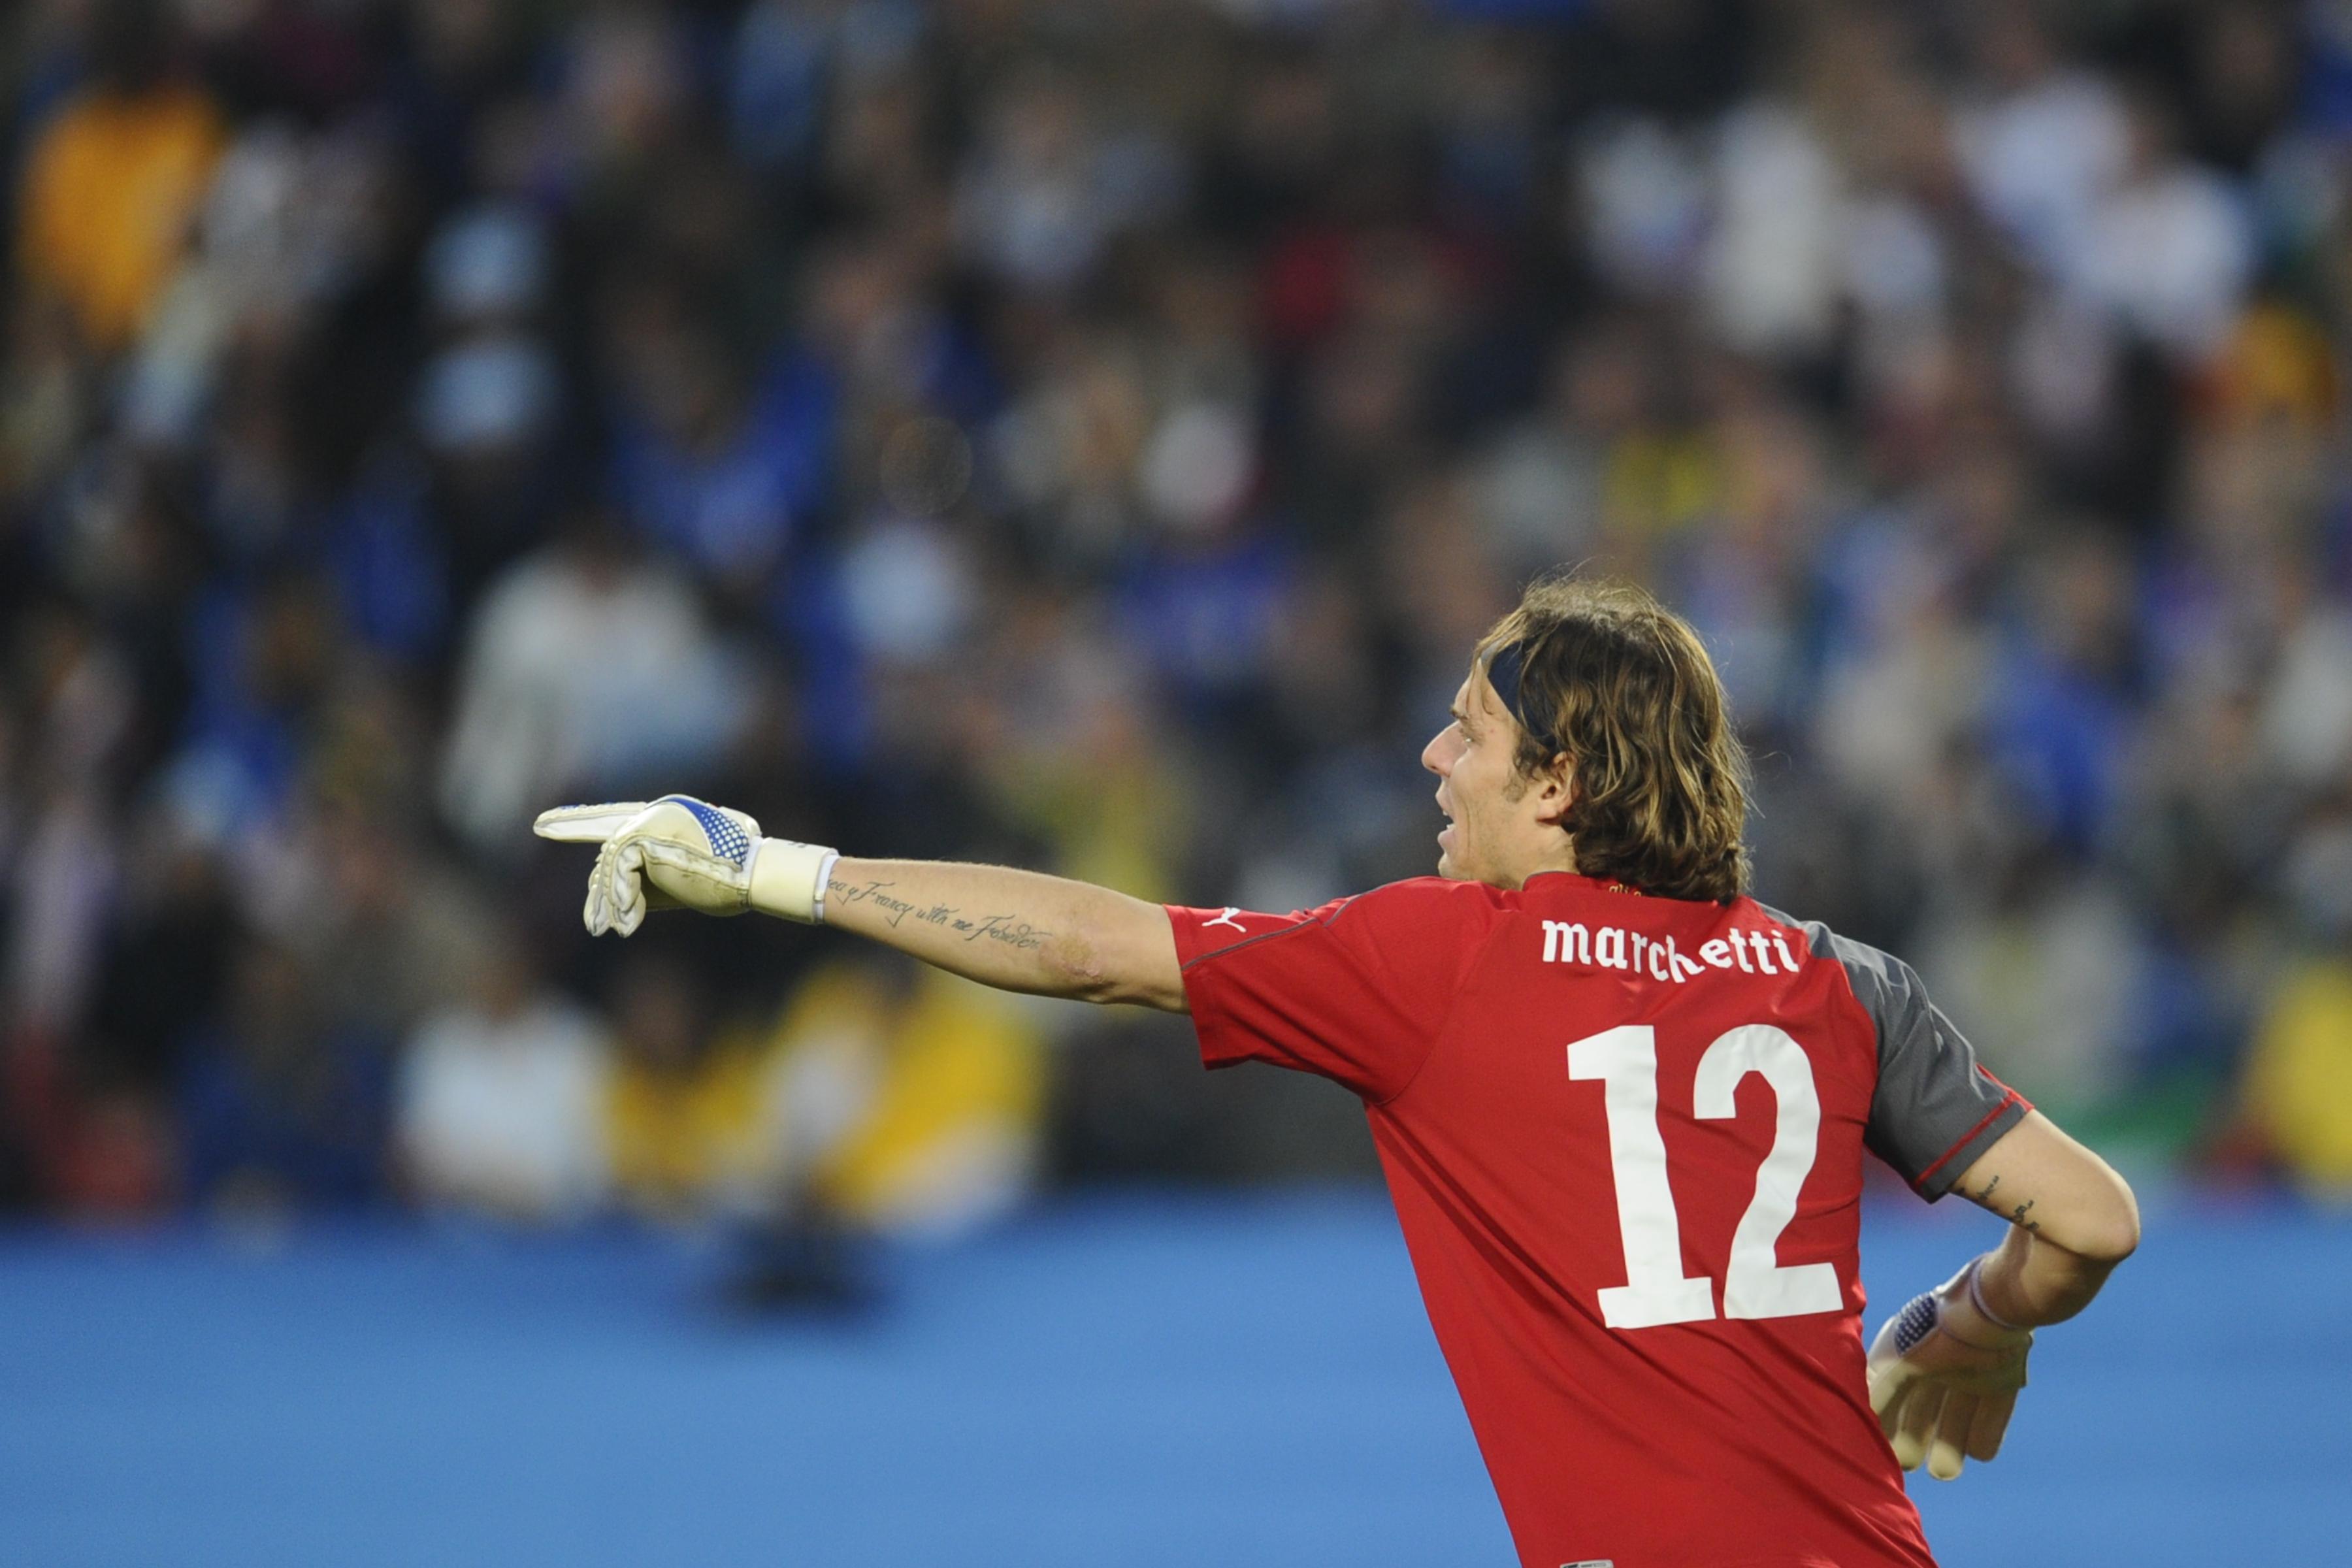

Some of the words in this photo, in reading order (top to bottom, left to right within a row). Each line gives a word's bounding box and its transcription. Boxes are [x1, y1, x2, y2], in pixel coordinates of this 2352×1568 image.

[916, 903, 960, 925] with
[951, 917, 974, 932] me
[1542, 920, 1799, 983] marchetti
[1567, 1023, 1844, 1330] 12
